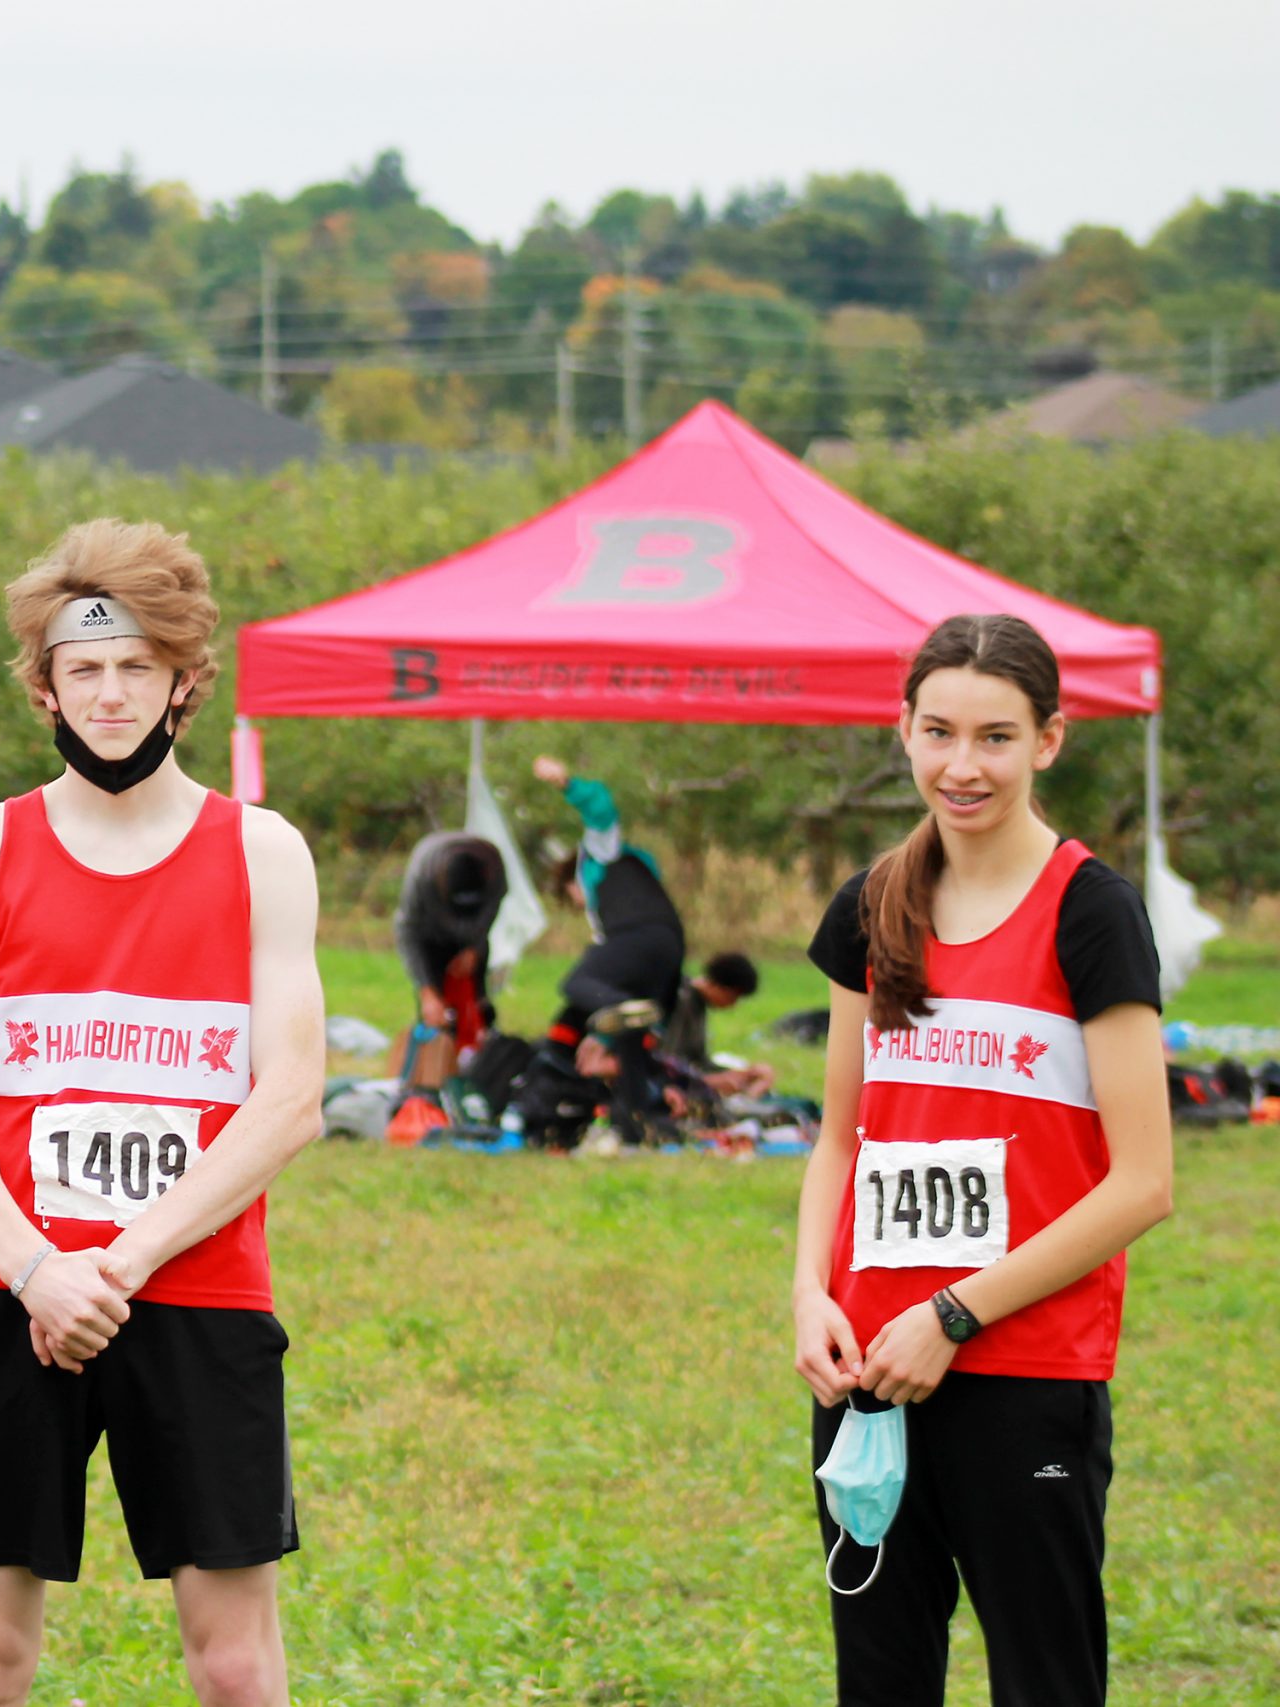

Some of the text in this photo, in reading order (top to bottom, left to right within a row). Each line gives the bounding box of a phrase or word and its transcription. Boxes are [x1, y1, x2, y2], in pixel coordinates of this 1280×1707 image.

[558, 517, 738, 604] B
[81, 618, 114, 627] adidas
[390, 648, 440, 702] B
[46, 1019, 192, 1069] HALIBURTON
[888, 1027, 1005, 1069] HALIBURTON
[48, 1131, 187, 1201] 1409
[868, 1166, 989, 1241] 1408
